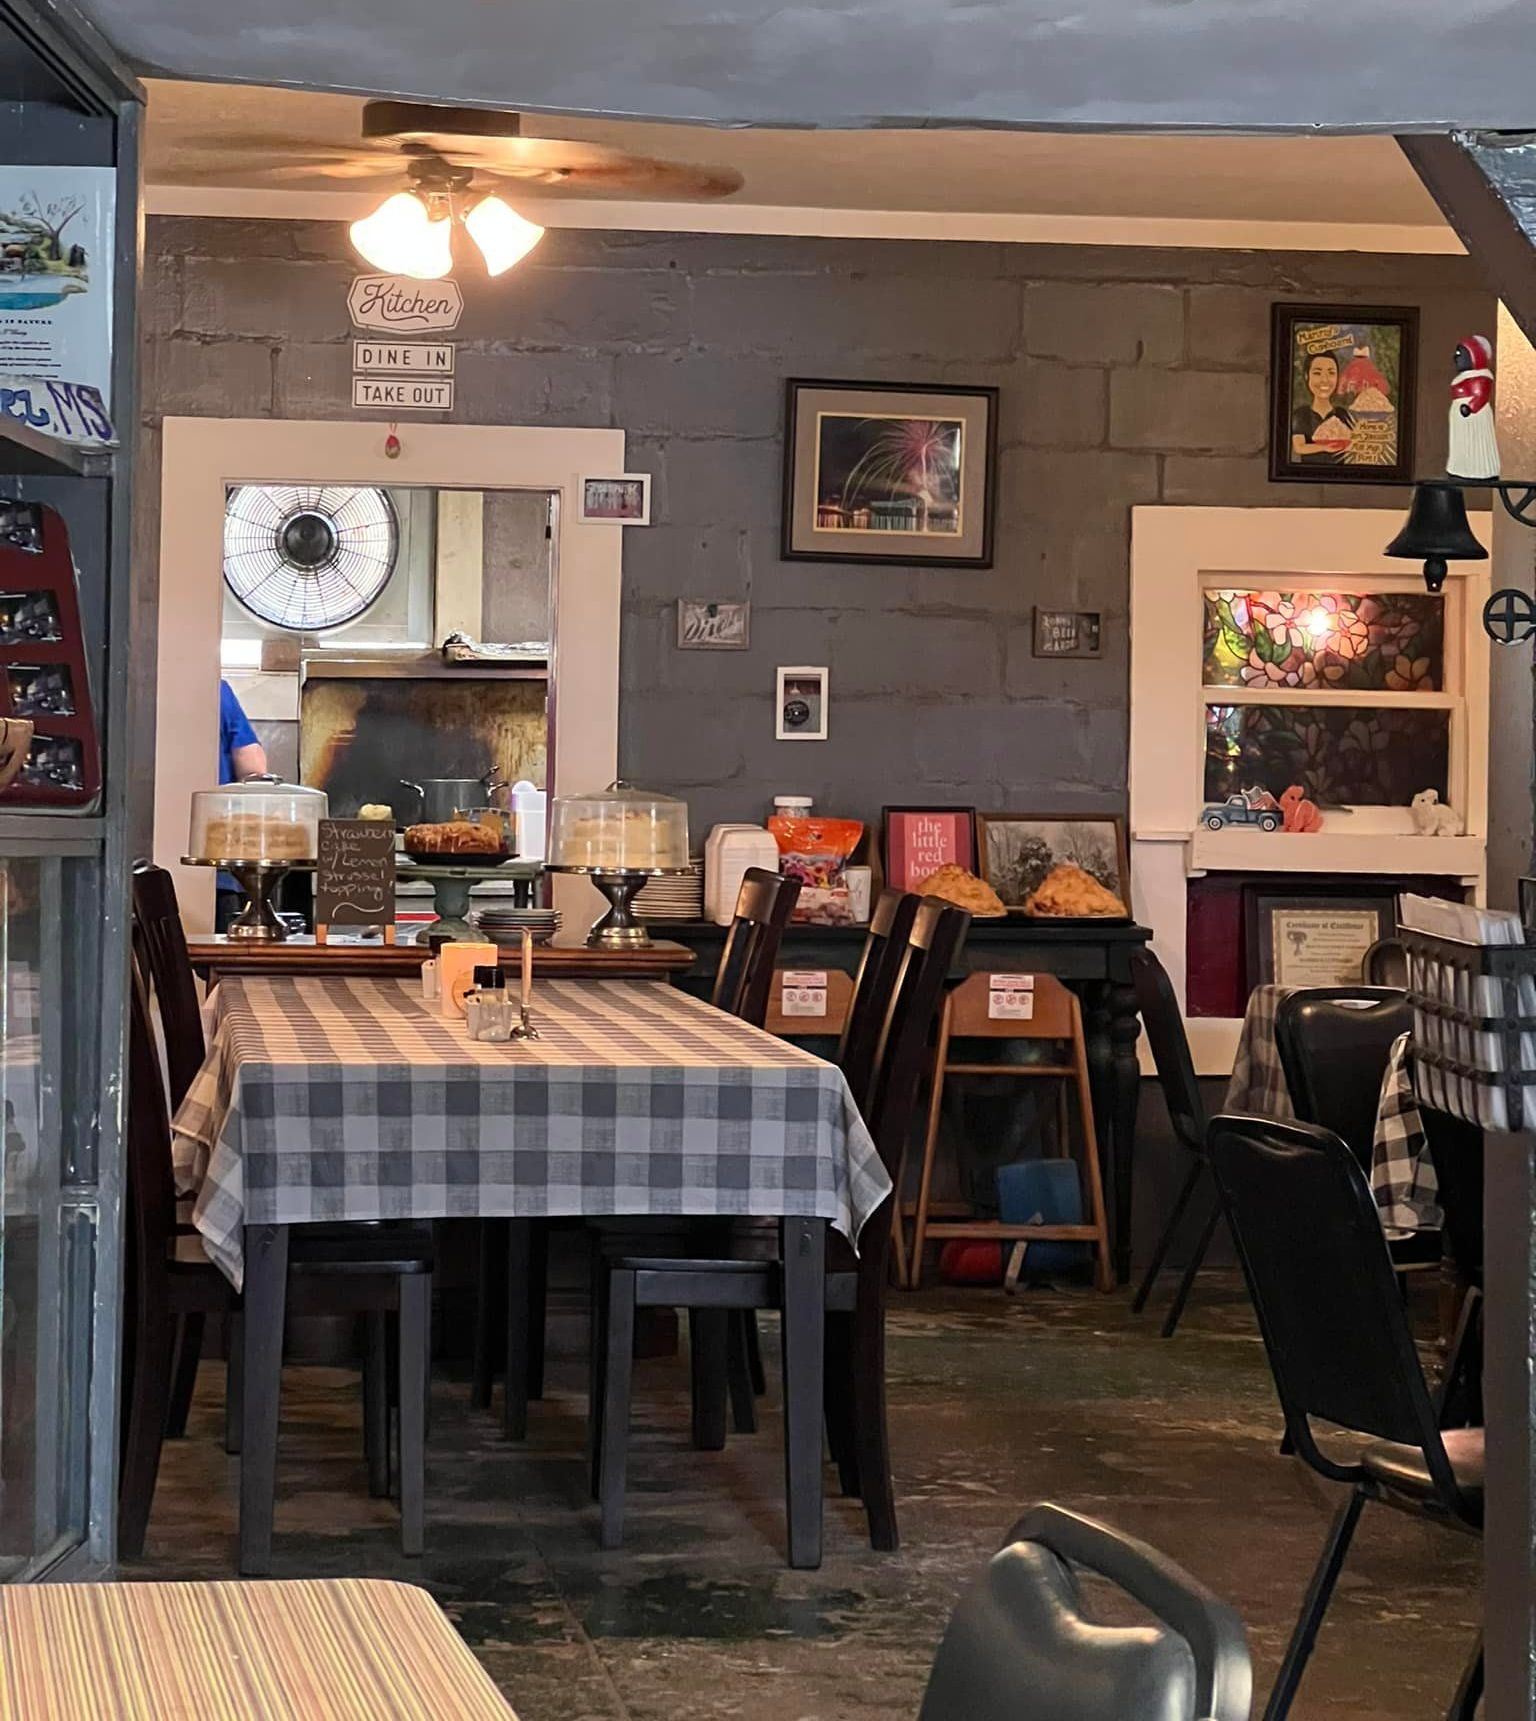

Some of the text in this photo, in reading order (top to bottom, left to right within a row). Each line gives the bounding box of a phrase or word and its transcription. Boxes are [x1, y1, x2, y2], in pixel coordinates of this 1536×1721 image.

[359, 283, 454, 322] Kitchen
[362, 349, 446, 366] DINE IN
[362, 386, 445, 403] TAKE OUT
[918, 817, 942, 833] the
[912, 831, 949, 848] little
[342, 853, 388, 868] Lemon
[918, 847, 944, 863] red
[910, 860, 944, 878] bo
